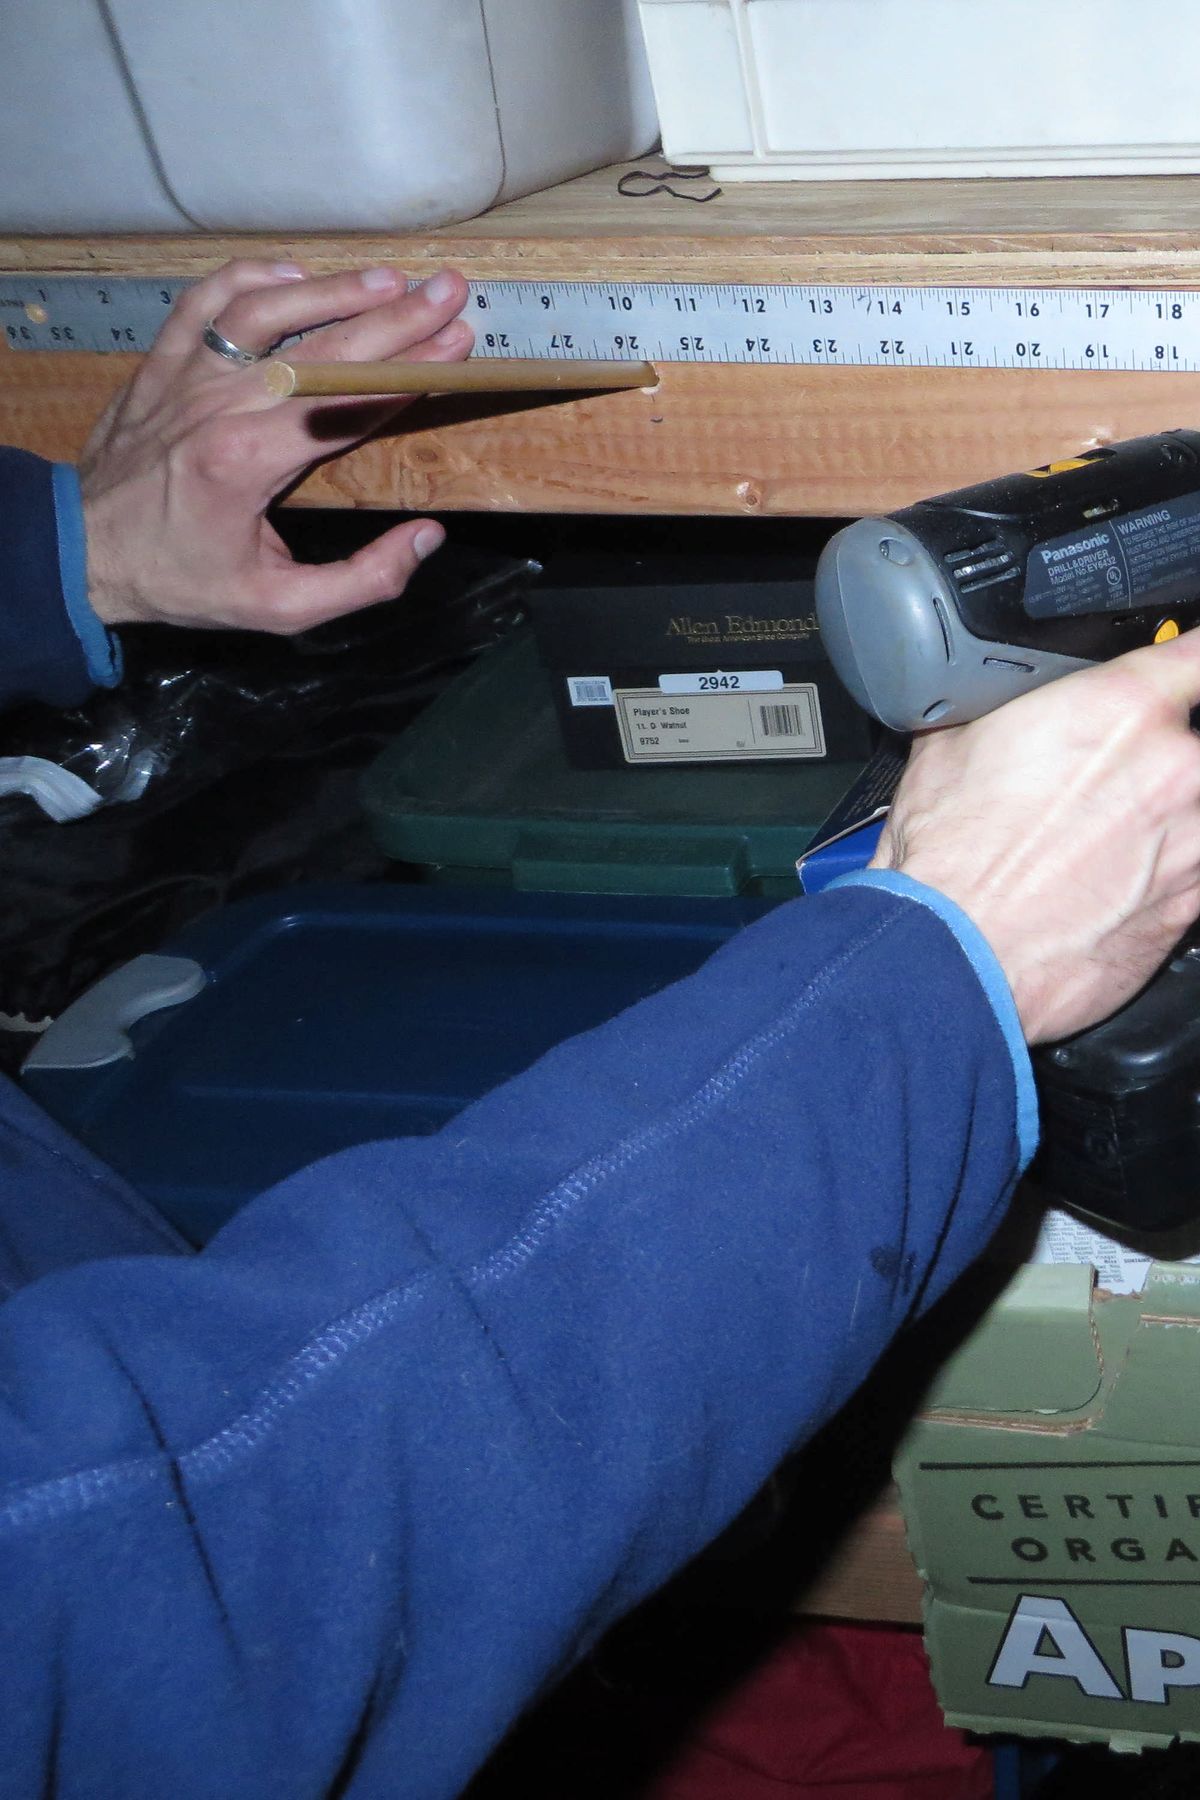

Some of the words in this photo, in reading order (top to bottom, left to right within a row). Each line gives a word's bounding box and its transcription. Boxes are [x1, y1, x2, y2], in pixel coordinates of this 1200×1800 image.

[477, 295, 486, 309] 8
[541, 296, 550, 310] 9
[609, 296, 632, 311] 10
[675, 298, 697, 312] 11
[742, 298, 766, 313] 12
[810, 299, 833, 314] 13
[879, 300, 902, 315] 14
[947, 302, 970, 316] 15
[1016, 303, 1040, 317] 16
[1085, 304, 1109, 319] 17
[1156, 304, 1182, 320] 18
[485, 333, 509, 348] 28
[551, 334, 574, 349] 27
[615, 335, 639, 350] 26
[680, 336, 704, 351] 25
[746, 338, 770, 352] 24
[813, 338, 837, 353] 23
[880, 340, 905, 355] 22
[951, 341, 974, 356] 21
[1016, 342, 1041, 357] 20
[1085, 343, 1109, 358] 19
[1155, 345, 1179, 360] 18
[1116, 509, 1171, 536] WARNING
[1040, 532, 1111, 565] Panasonic
[1047, 549, 1110, 577] DRILL&DRIVER
[1049, 571, 1075, 586] Model
[665, 616, 720, 636] Allen
[698, 675, 741, 690] 2942
[633, 706, 668, 717] Player's
[669, 706, 690, 716] Shoe
[660, 721, 687, 730] Walnut
[639, 737, 660, 746] 9752
